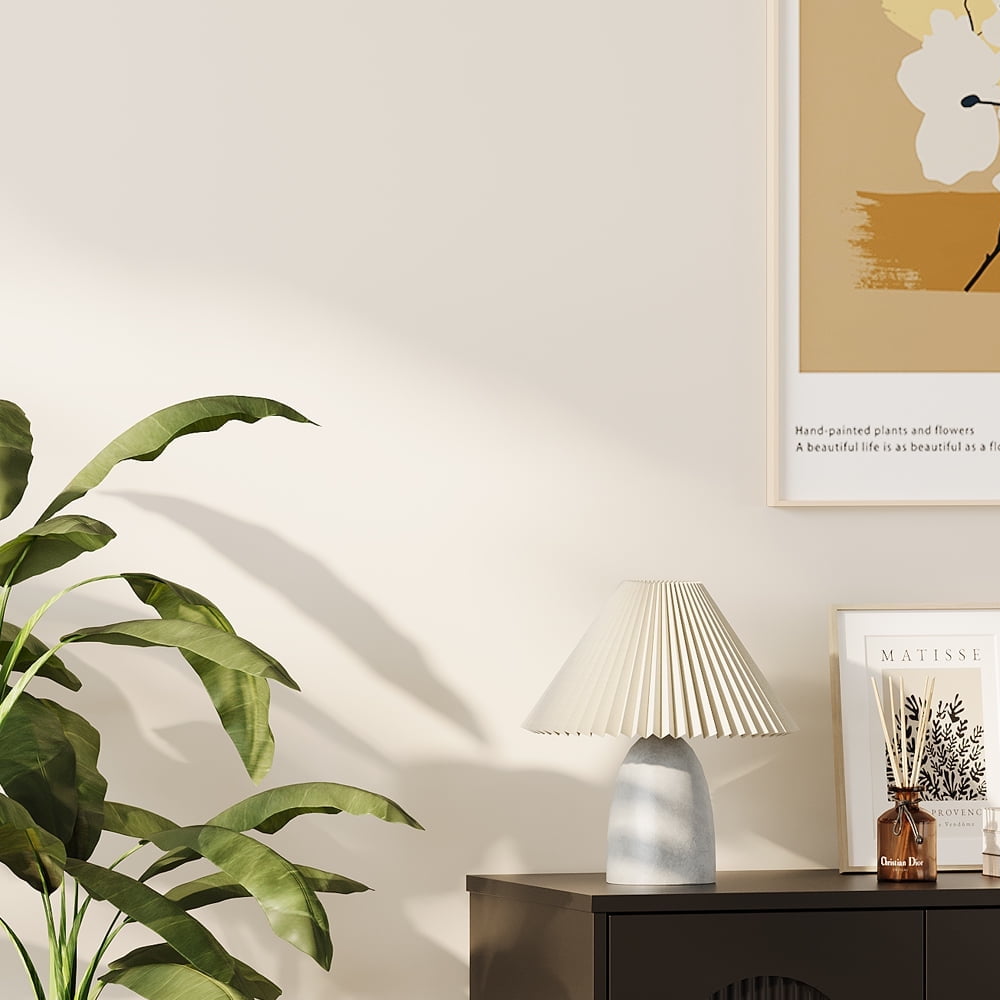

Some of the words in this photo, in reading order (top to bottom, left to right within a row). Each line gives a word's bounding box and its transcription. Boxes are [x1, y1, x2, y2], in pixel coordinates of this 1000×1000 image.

[795, 426, 871, 437] Hand-painted
[874, 426, 908, 437] plants
[911, 426, 932, 436] and
[935, 426, 975, 436] flowers
[795, 442, 804, 453] A
[807, 442, 858, 453] beautiful
[861, 442, 880, 453] life
[883, 442, 892, 453] is
[895, 443, 907, 453] as
[911, 442, 962, 453] beautiful
[965, 443, 976, 453] as
[980, 443, 986, 453] a
[881, 648, 982, 662] MATISSE
[931, 808, 983, 817] PROVENC
